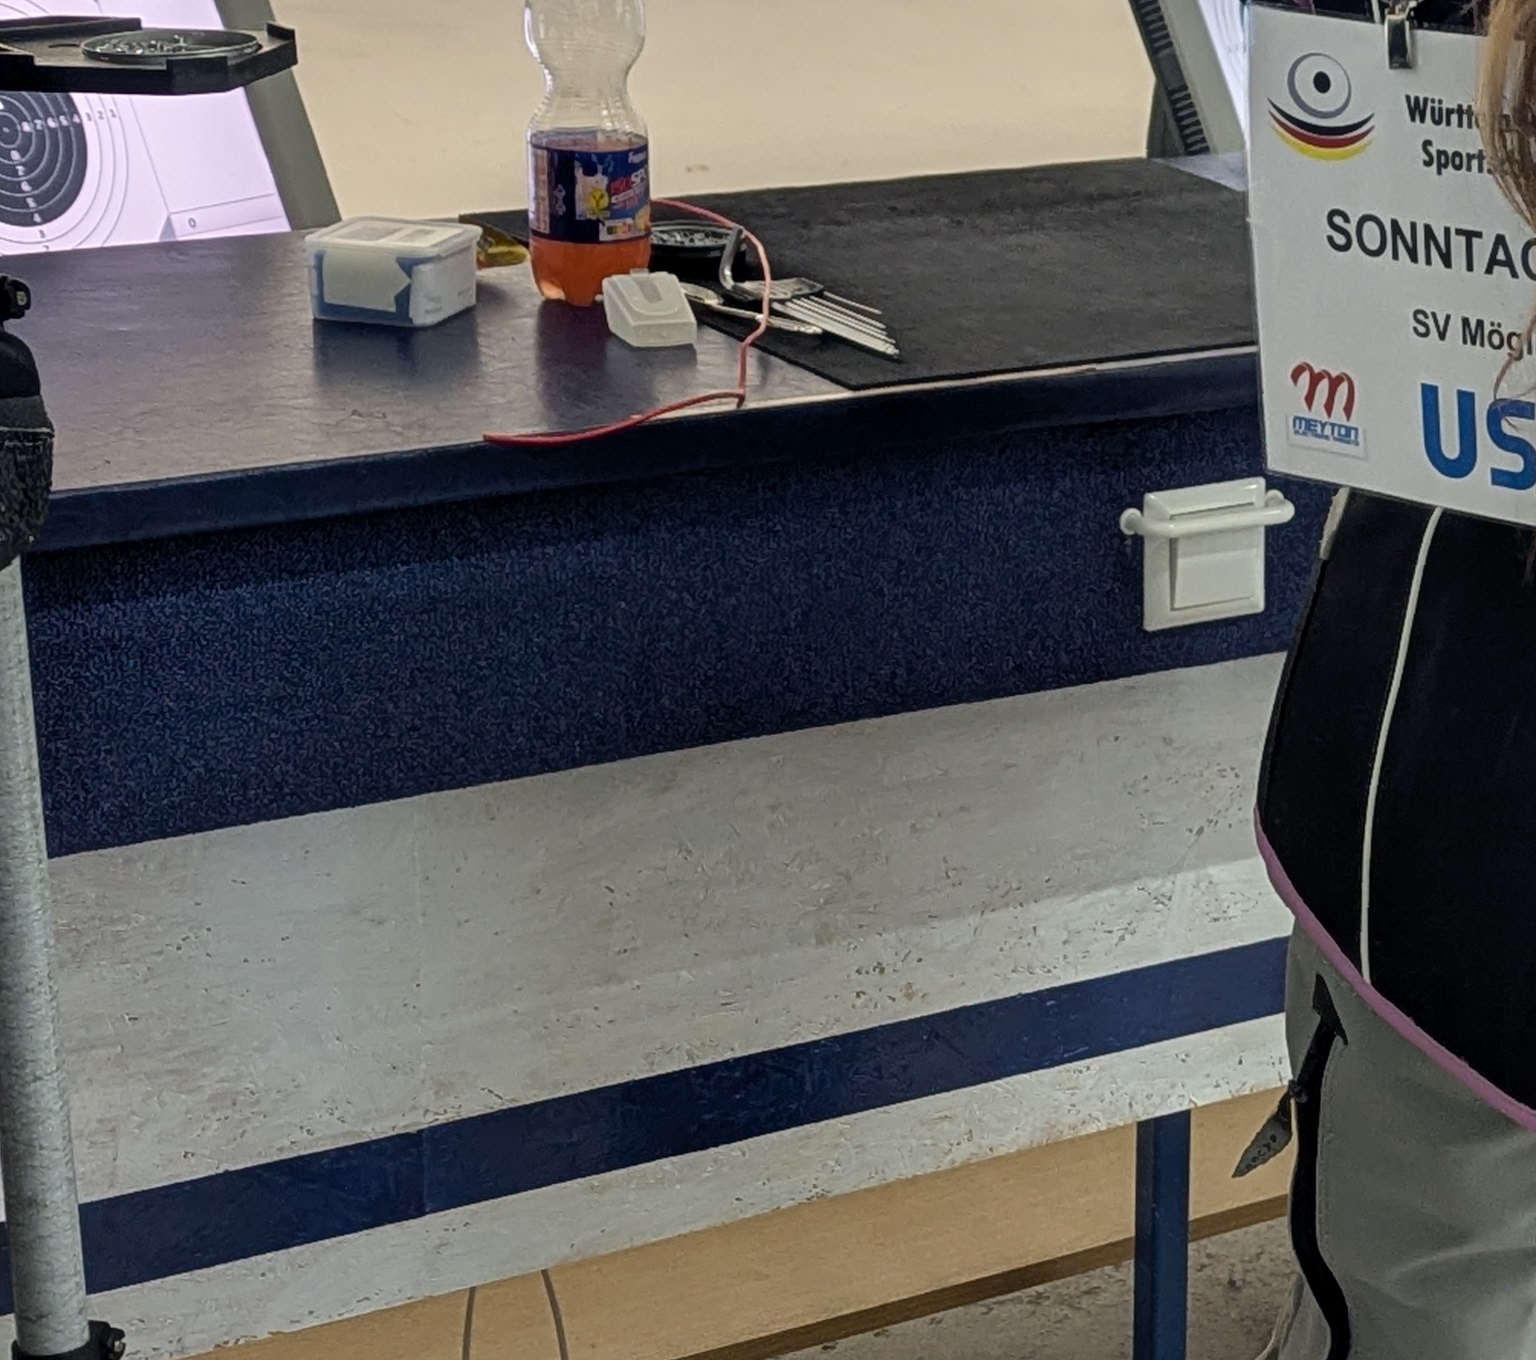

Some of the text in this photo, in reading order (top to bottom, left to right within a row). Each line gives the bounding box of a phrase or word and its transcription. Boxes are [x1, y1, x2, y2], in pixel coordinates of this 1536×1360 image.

[1404, 93, 1481, 130] Württ
[1421, 139, 1493, 176] Sport
[1412, 308, 1452, 341] SV
